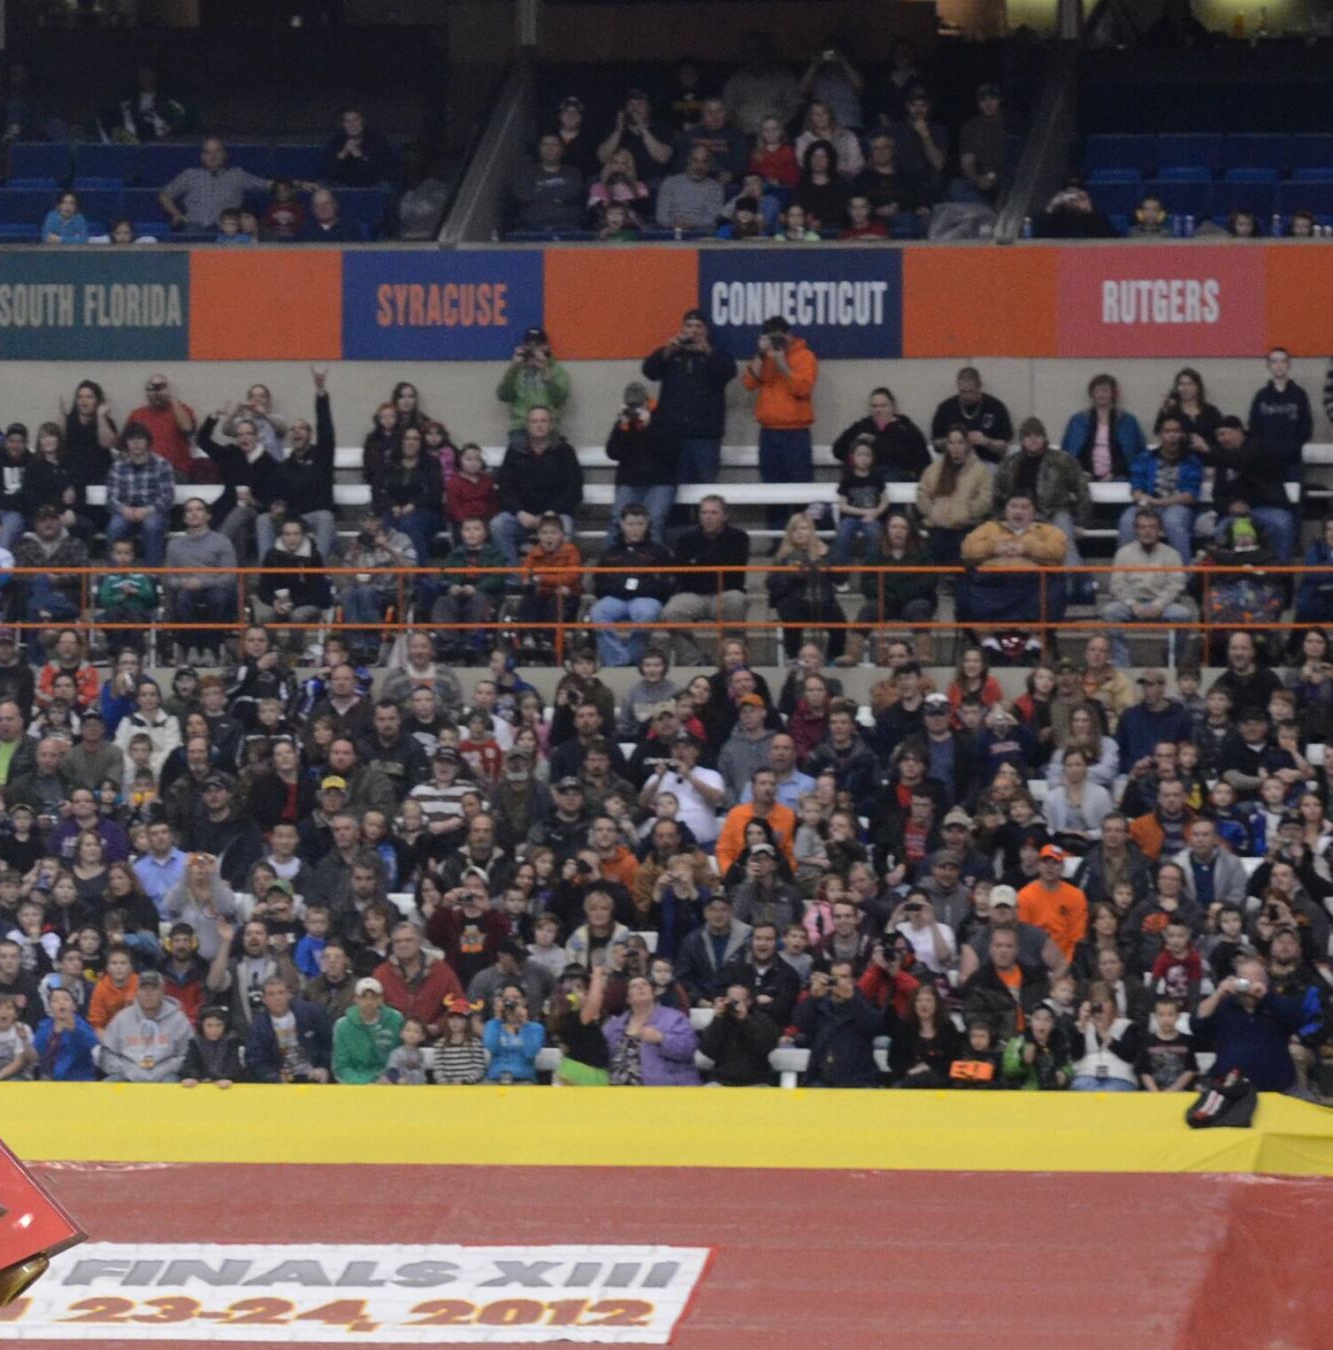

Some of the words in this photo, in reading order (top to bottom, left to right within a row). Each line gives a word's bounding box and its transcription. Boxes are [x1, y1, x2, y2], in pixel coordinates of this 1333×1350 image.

[83, 283, 182, 327] FLORIDA
[376, 282, 507, 326] SYRACUSE
[711, 281, 887, 326] CONNECTICUT
[1102, 279, 1220, 323] RUTGERS
[62, 1258, 474, 1289] FINALS
[481, 1261, 679, 1289] XIII
[53, 1296, 380, 1333] 23-24,
[406, 1298, 656, 1328] 2012
